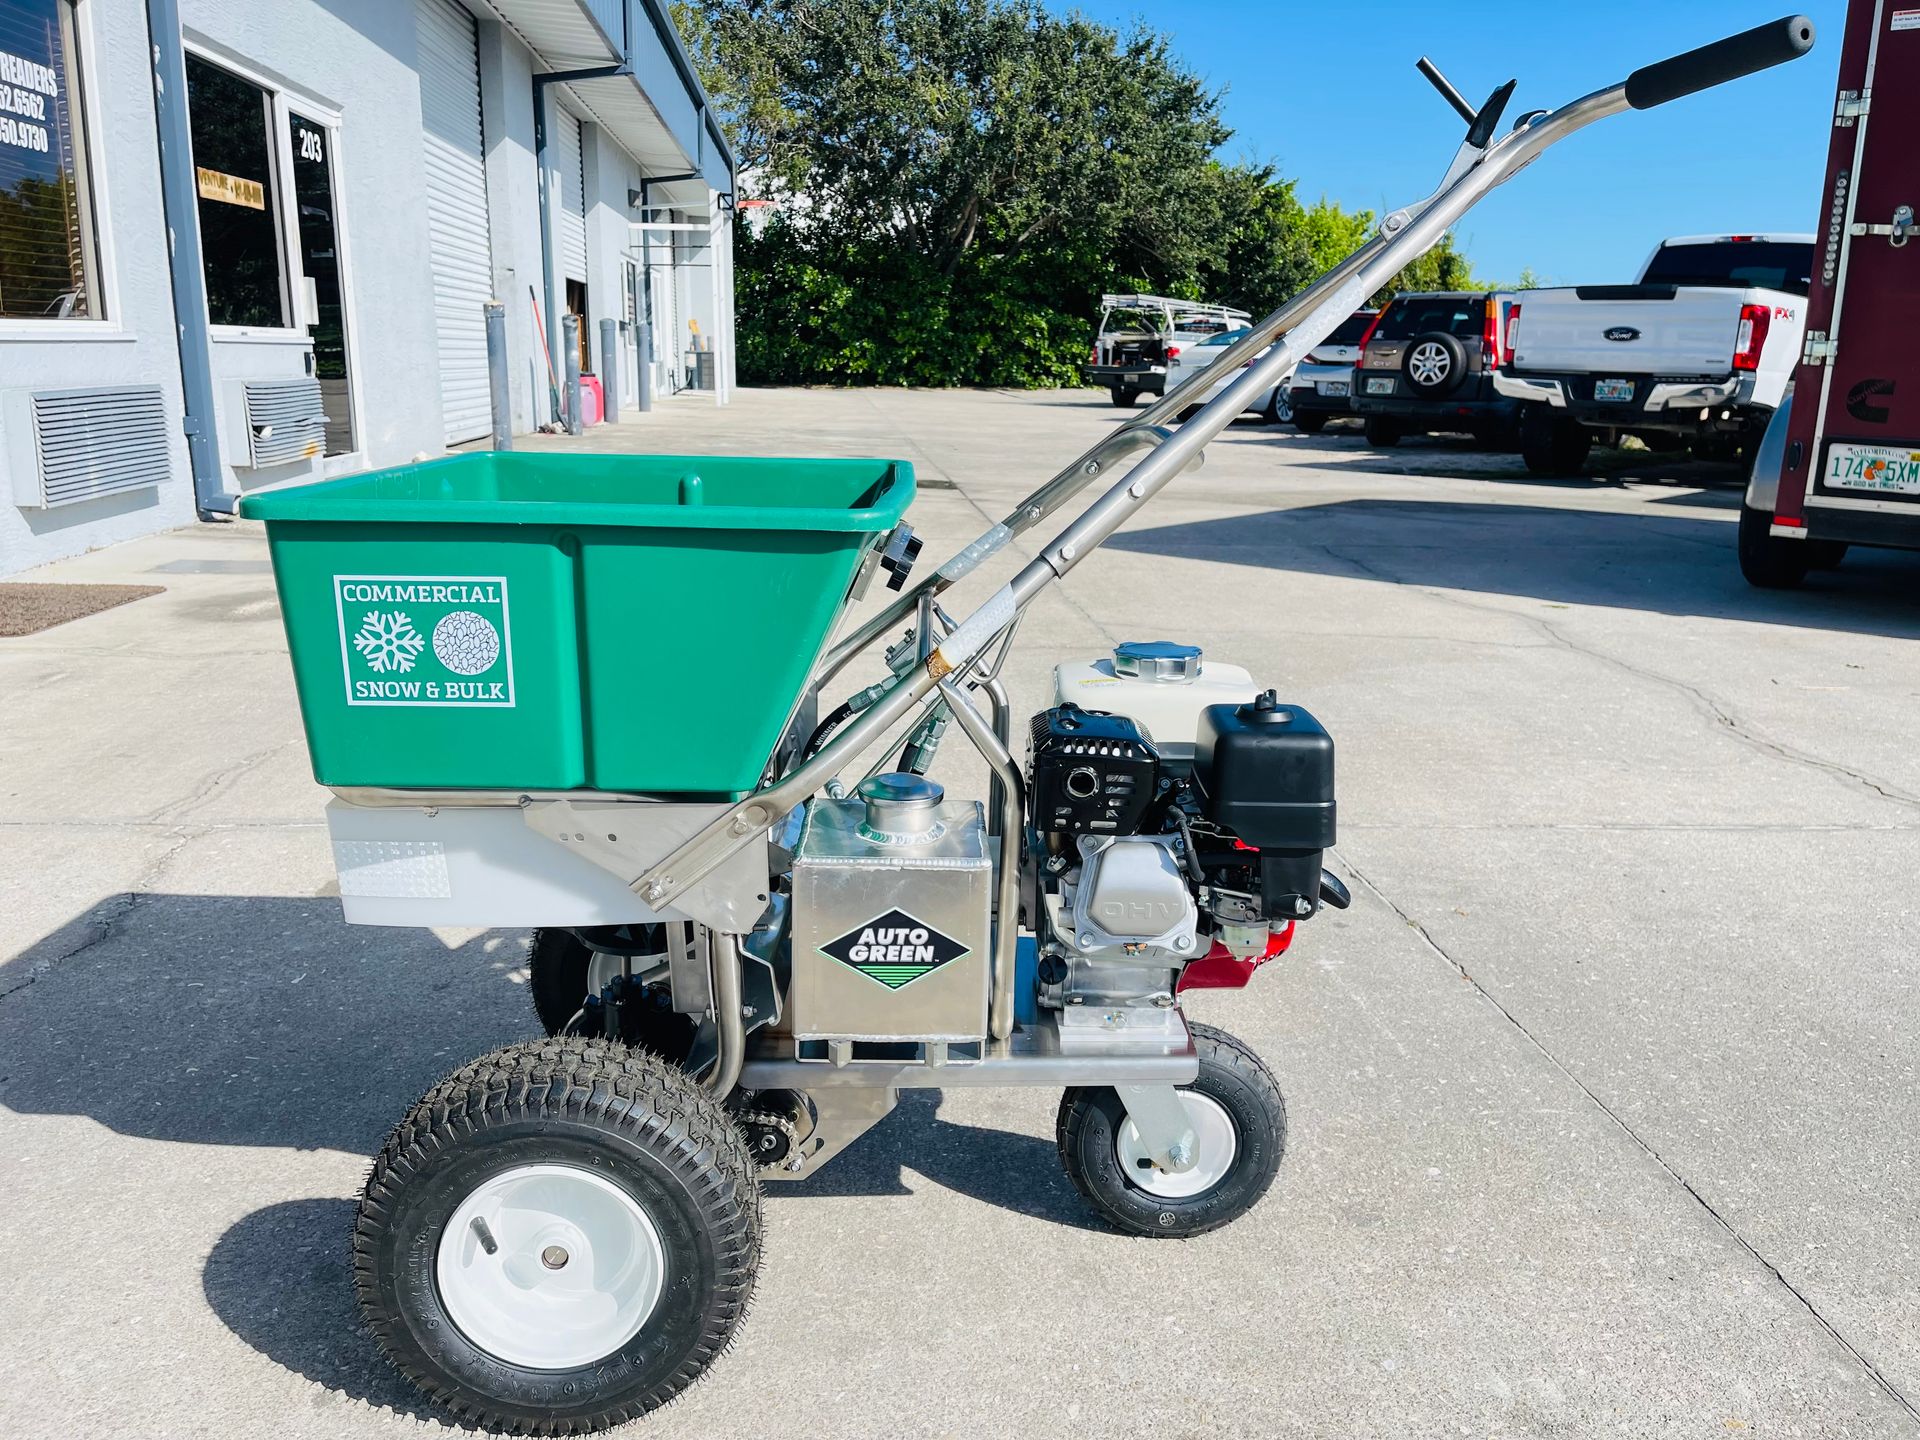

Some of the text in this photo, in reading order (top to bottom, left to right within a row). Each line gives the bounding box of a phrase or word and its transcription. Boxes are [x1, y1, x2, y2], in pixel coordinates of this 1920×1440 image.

[0, 116, 49, 153] 50.9730
[300, 129, 322, 163] 203
[1774, 306, 1795, 321] FX4
[1609, 331, 1633, 340] Ford
[1853, 480, 1867, 488] GOD
[1868, 481, 1877, 489] WE
[343, 585, 500, 603] COMMERCIAL
[355, 681, 505, 699] SNOW & BULK
[814, 721, 837, 746] WINNER
[1103, 901, 1179, 920] OHV
[857, 927, 929, 945] AUTO
[848, 945, 935, 963] GREEN
